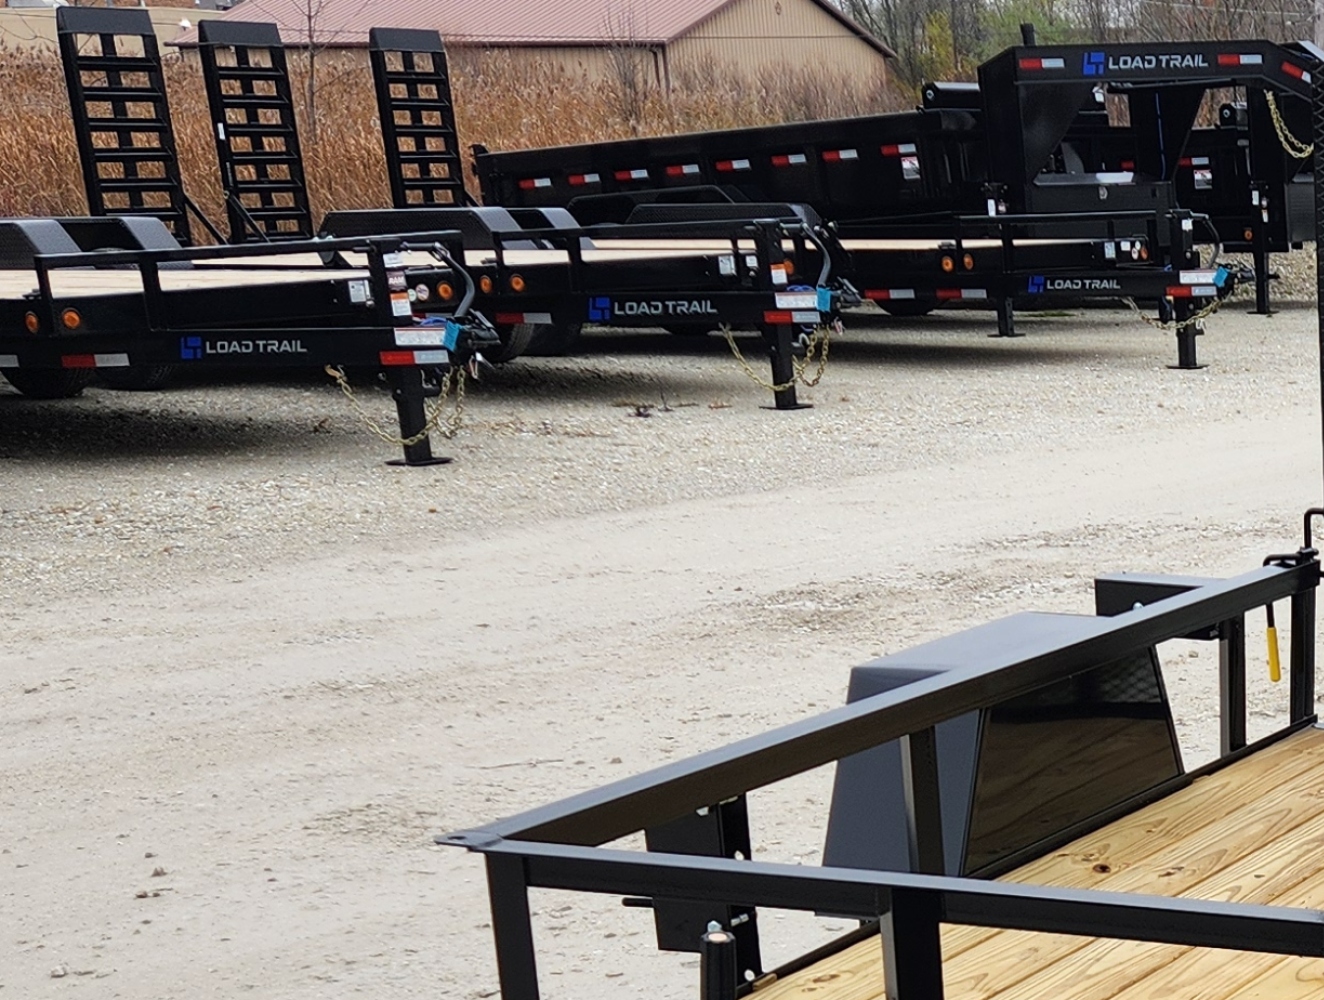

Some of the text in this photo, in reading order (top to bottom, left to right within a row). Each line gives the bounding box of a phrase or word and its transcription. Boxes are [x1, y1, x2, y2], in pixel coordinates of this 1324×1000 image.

[1108, 54, 1209, 70] LOAD TRAIL
[1046, 279, 1121, 290] LOAD TRAIL
[614, 300, 718, 315] LOAD TRAIL
[205, 340, 308, 354] LOAD TRAIL
